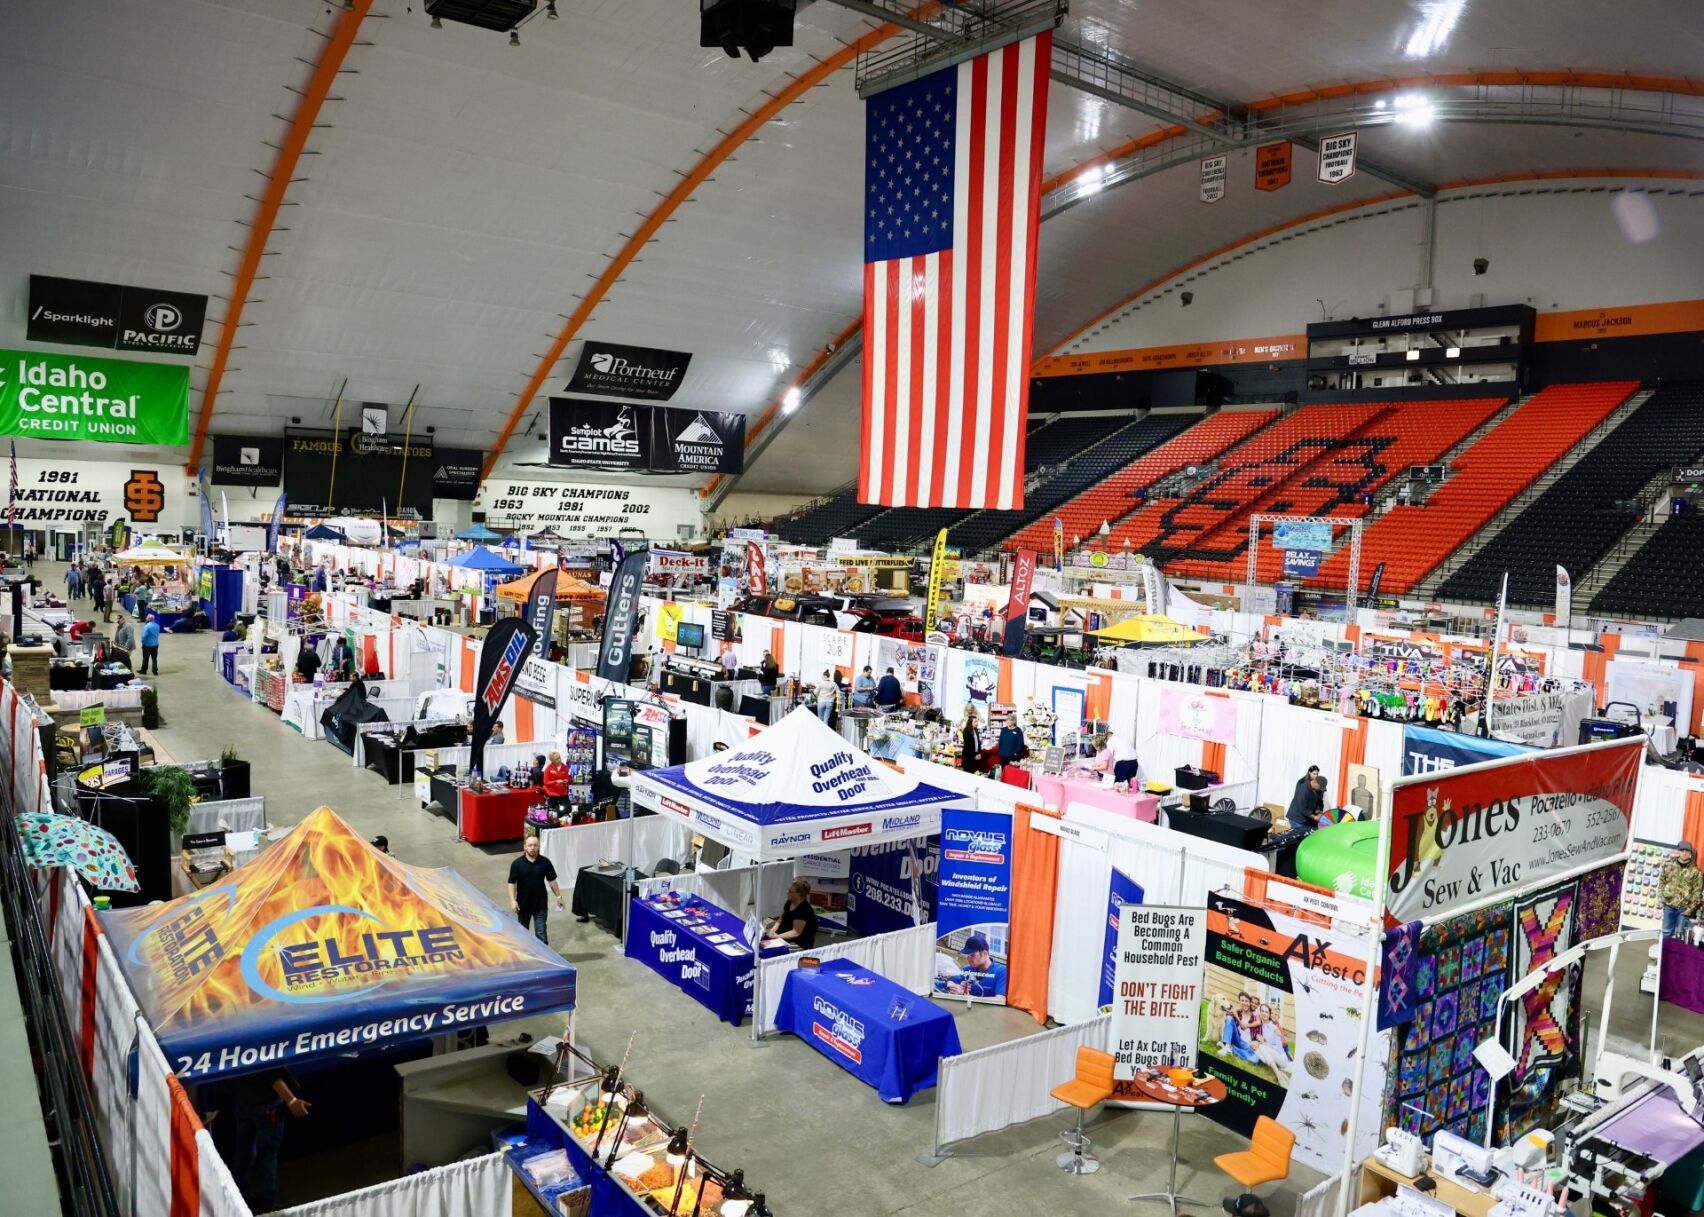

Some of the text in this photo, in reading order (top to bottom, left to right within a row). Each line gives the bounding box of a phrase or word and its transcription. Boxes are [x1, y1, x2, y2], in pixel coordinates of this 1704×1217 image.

[1325, 138, 1351, 151] BIG SKY
[1323, 149, 1353, 160] CHAMPIONS
[43, 311, 114, 327] Sparklight
[1373, 315, 1442, 328] GLENN ALFORD PRESS BOX
[1573, 317, 1632, 329] MARCUS JACKSON
[123, 329, 196, 346] PACIFIC
[19, 360, 107, 390] Idaho
[611, 357, 679, 381] Portneuf
[584, 373, 670, 387] MEDICAL CENTER
[18, 387, 140, 418] Central
[18, 418, 136, 435] CREDIT UNION
[571, 426, 602, 438] Simplot
[293, 440, 342, 452] FAMOUS
[675, 443, 723, 455] MOUNTAIN
[678, 454, 719, 465] AMERICA
[38, 471, 78, 484] 1981
[13, 489, 101, 503] NATIONAL
[507, 486, 630, 500] BIG SKY CHAMPIONS
[0, 507, 108, 521] CHAMPIONS
[493, 500, 650, 514] 1963 1981 2002
[506, 513, 629, 524] ROCKY MOUNTAIN CHAMPIONS
[659, 556, 705, 567] Deck-it
[1284, 559, 1316, 567] SAVINGS
[1285, 551, 1310, 560] RELAX
[1014, 557, 1030, 606] ALTOZ
[608, 574, 635, 666] Gutters
[482, 628, 529, 717] AMSOIL
[707, 764, 771, 780] Overhead
[810, 750, 854, 778] Quality
[703, 775, 740, 786] Door
[812, 764, 871, 794] Overhead
[837, 782, 867, 801] Door
[1530, 788, 1577, 816] Pocatello
[770, 833, 811, 846] RAYNOR
[824, 826, 870, 839] LiftMaster
[882, 814, 920, 829] MIDLAND
[1390, 795, 1520, 893] Jones
[941, 879, 1008, 893] Windshield Repair
[952, 873, 997, 883] Inventors of
[1422, 858, 1521, 909] Sew & Vac
[1132, 912, 1194, 928] Bed Bugs Are
[170, 906, 225, 977] ELITE
[650, 930, 677, 947] Quality
[1134, 926, 1189, 942] Becoming A
[280, 926, 460, 975] ELITE
[1142, 939, 1182, 952] Common
[1282, 933, 1332, 968] Ax
[158, 925, 191, 985] RESTORATION
[660, 947, 696, 962] Overhead
[1124, 952, 1198, 967] Household Pest
[1221, 939, 1281, 969] Safer Organic
[285, 950, 465, 986] RESTORATION
[681, 964, 702, 979] Door
[1215, 951, 1284, 984] Based Products
[1311, 955, 1348, 982] Pest
[287, 981, 316, 993] Wind
[1121, 982, 1196, 1000] DON'T FIGHT
[1311, 975, 1339, 992] Cutting
[1340, 983, 1352, 994] the
[1124, 1000, 1189, 1018] THE BITE...
[176, 996, 524, 1078] 24 Hour Emergency Service
[1119, 1039, 1186, 1054] Let Ax Cut The
[1115, 1052, 1189, 1067] Bed Bugs Of
[1208, 1066, 1267, 1099] Family & Pet
[1226, 1087, 1256, 1106] iendly
